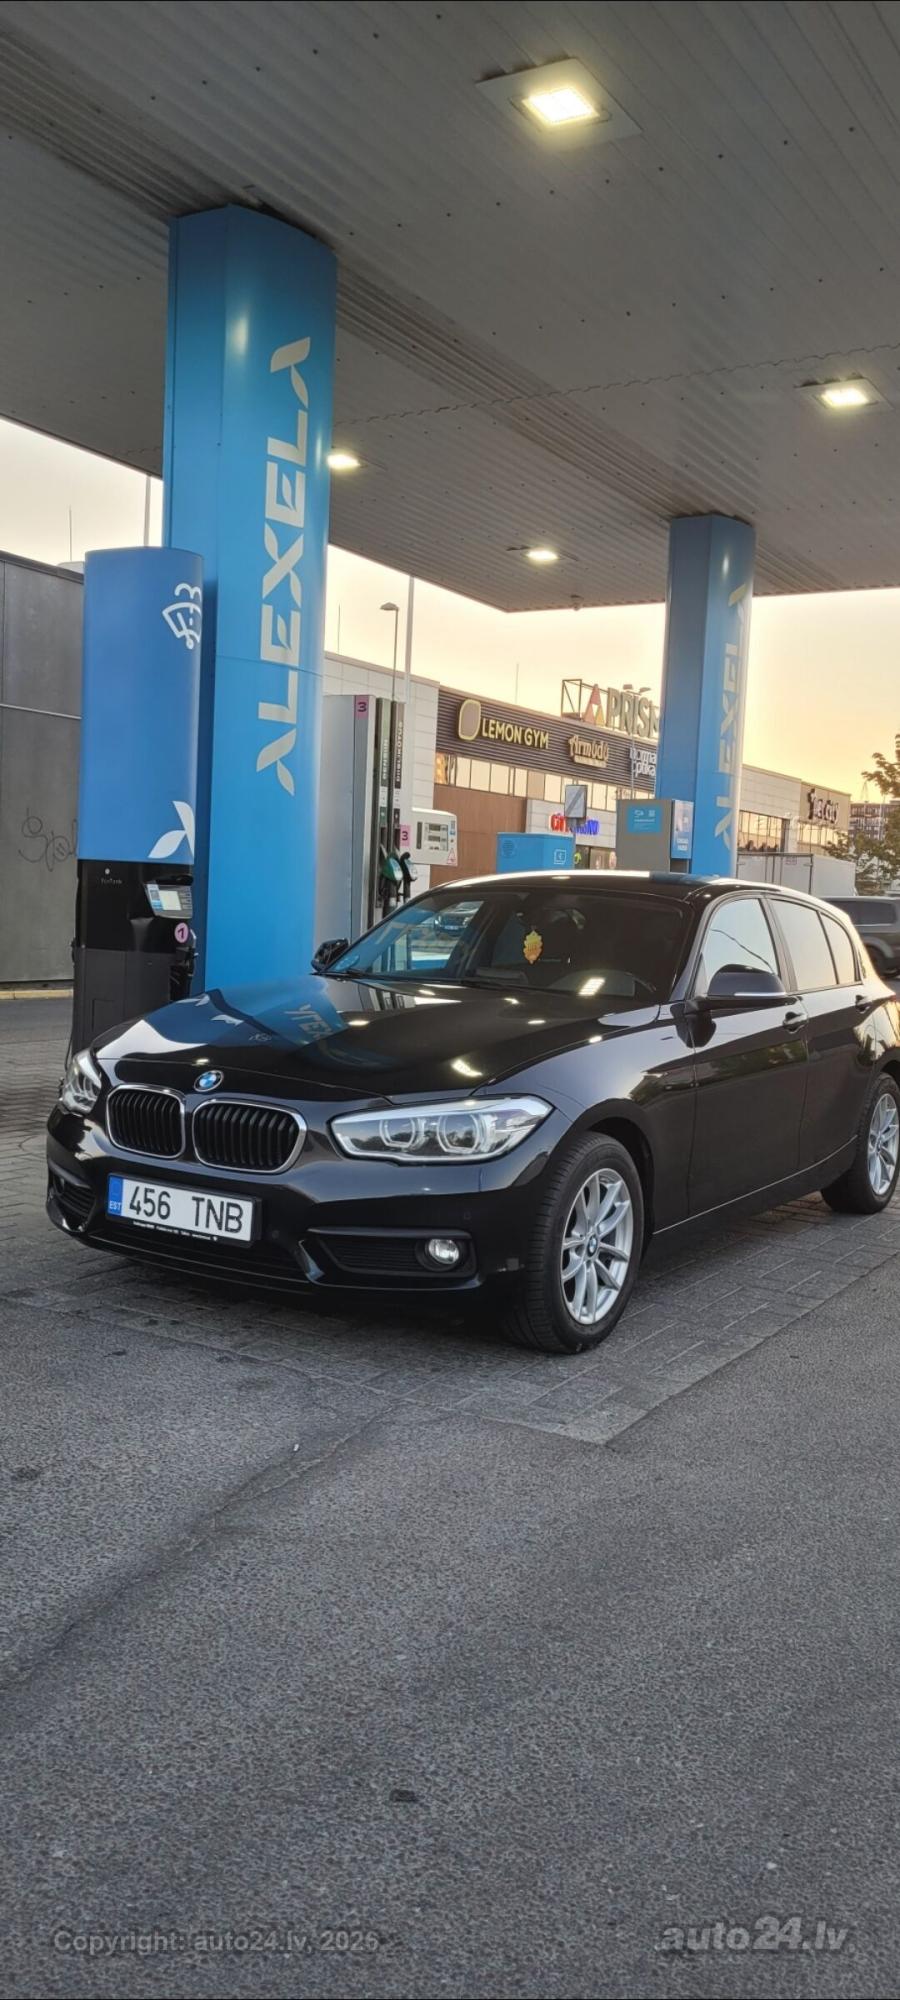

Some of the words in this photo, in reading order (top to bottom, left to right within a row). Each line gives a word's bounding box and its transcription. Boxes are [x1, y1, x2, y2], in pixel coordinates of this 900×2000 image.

[255, 336, 311, 797] ALEXELA
[357, 701, 367, 712] 3
[481, 717, 522, 745] LEMON
[524, 727, 549, 750] GYM
[401, 830, 409, 841] 3
[109, 1201, 121, 1211] EST
[129, 1185, 171, 1220] 456
[192, 1196, 244, 1234] TNB
